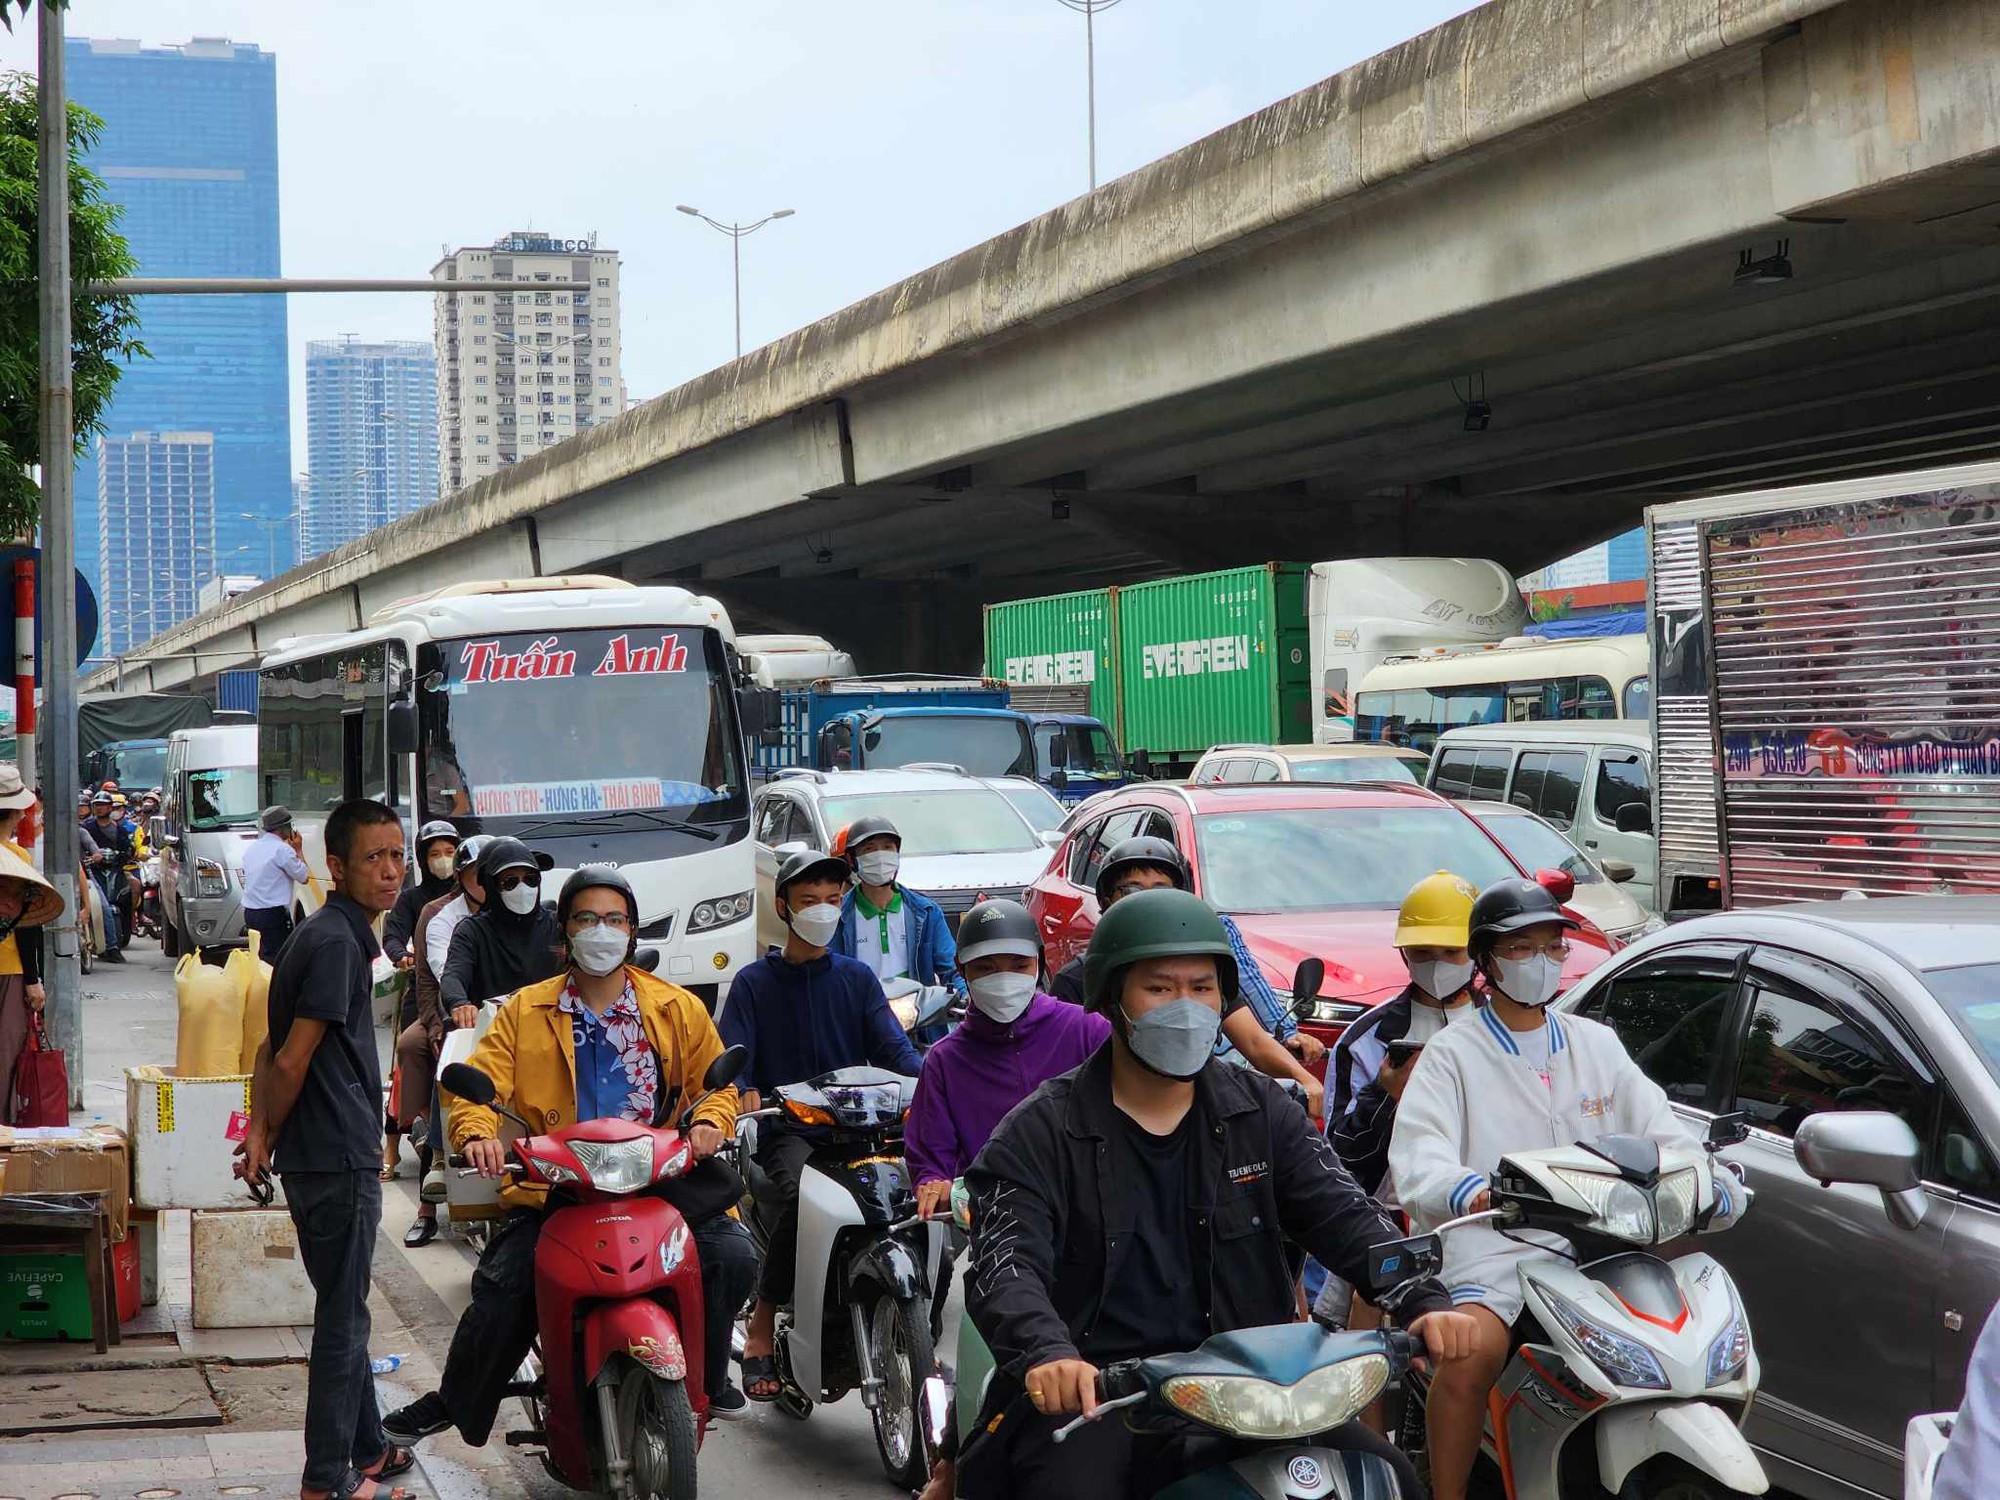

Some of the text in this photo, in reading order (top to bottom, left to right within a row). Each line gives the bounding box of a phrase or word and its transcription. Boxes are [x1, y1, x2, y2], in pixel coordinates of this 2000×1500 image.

[460, 634, 689, 684] Tuấn Anh
[1006, 650, 1095, 685] EVERGREEN
[1143, 634, 1248, 679] EVERGREEN
[1903, 742, 1914, 774] IN
[1990, 741, 2000, 775] B
[596, 1215, 632, 1224] HONDA
